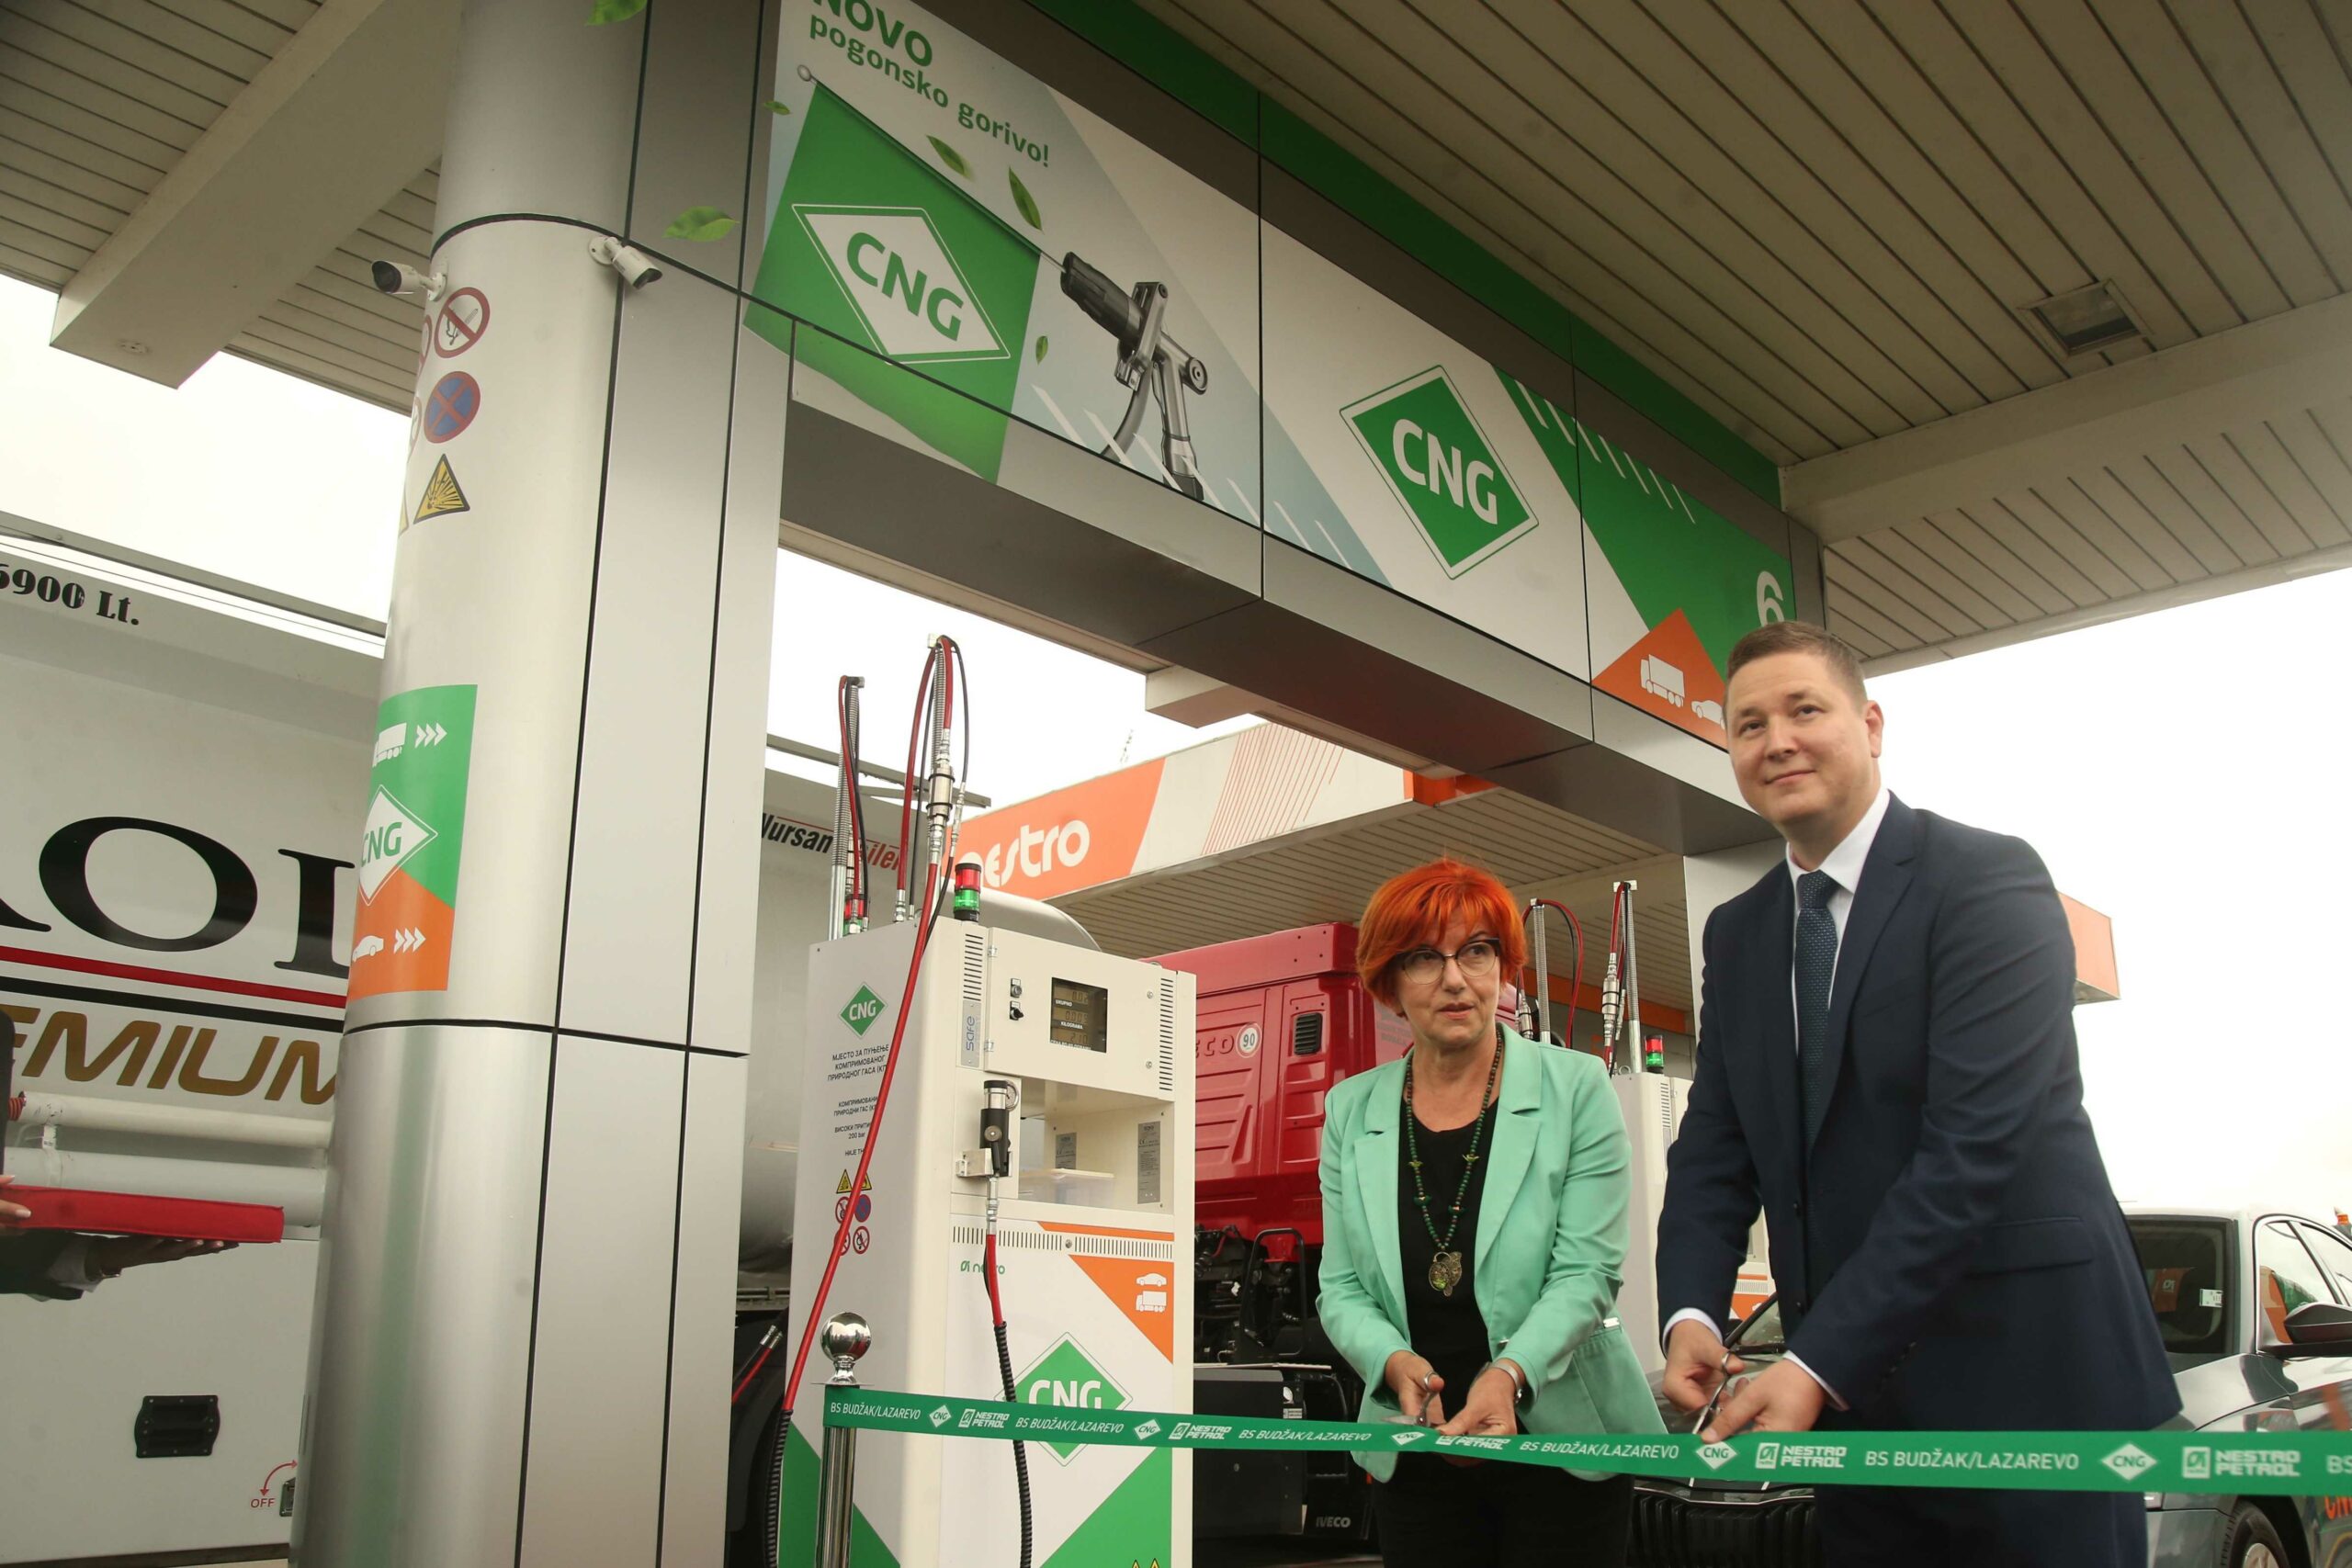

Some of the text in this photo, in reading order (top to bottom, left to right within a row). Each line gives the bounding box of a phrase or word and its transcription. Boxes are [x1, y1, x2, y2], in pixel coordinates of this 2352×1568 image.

[809, 14, 1049, 167] pogonsko gorivo!
[845, 231, 964, 341] CNG
[1392, 418, 1498, 525] CNG
[96, 590, 139, 626] Lt.
[849, 999, 876, 1021] CNG
[1243, 1032, 1256, 1047] 90
[862, 1066, 876, 1076] ГАСА
[1028, 1379, 1102, 1409] CNG
[831, 1402, 921, 1420] BS BUDŽAK/LAZAREVO
[933, 1411, 948, 1420] CNG
[975, 1412, 1010, 1421] NESTRO
[972, 1418, 1005, 1428] PETROL
[1015, 1417, 1125, 1434] BS BUDŽAK/LAZAREVO
[1190, 1425, 1232, 1433] NESTRO
[1137, 1426, 1156, 1434] CNG
[1185, 1431, 1227, 1440] PETROL
[1238, 1428, 1372, 1441] BS BUDŽAK/LAZAREVO
[1520, 1440, 1679, 1459] BS BUDŽAK/LAZAREVO
[1702, 1447, 1730, 1459] CNG
[1781, 1446, 1847, 1457] NESTRO
[1781, 1456, 1845, 1468] PETROL
[1866, 1449, 2079, 1470] BS BUDŽAK/LAZAREVO
[2112, 1455, 2146, 1468] CNG
[2215, 1450, 2301, 1464] NESTRO
[2215, 1462, 2301, 1477] PETROL
[250, 1497, 275, 1509] OFF
[1316, 1517, 1351, 1529] IVECO
